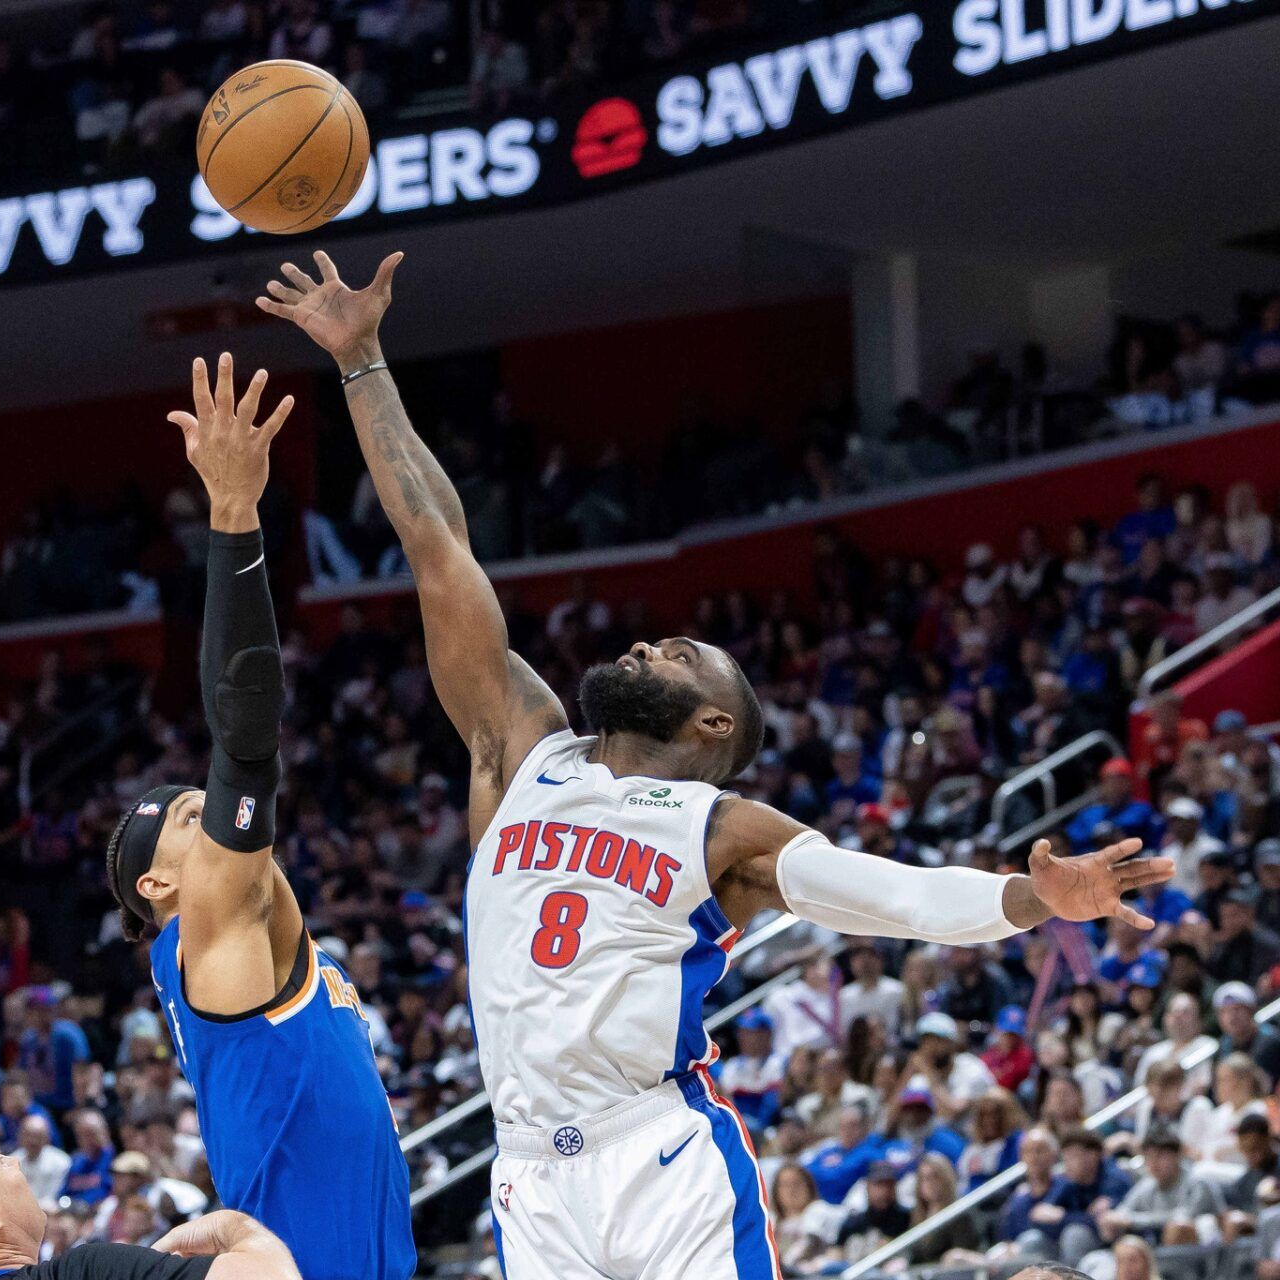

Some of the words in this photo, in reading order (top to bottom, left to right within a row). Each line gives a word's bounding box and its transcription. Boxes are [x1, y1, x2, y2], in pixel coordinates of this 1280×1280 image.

[658, 13, 919, 156] SAVVY
[628, 797, 683, 809] StockX
[492, 820, 683, 908] PISTONS
[531, 891, 589, 969] 8
